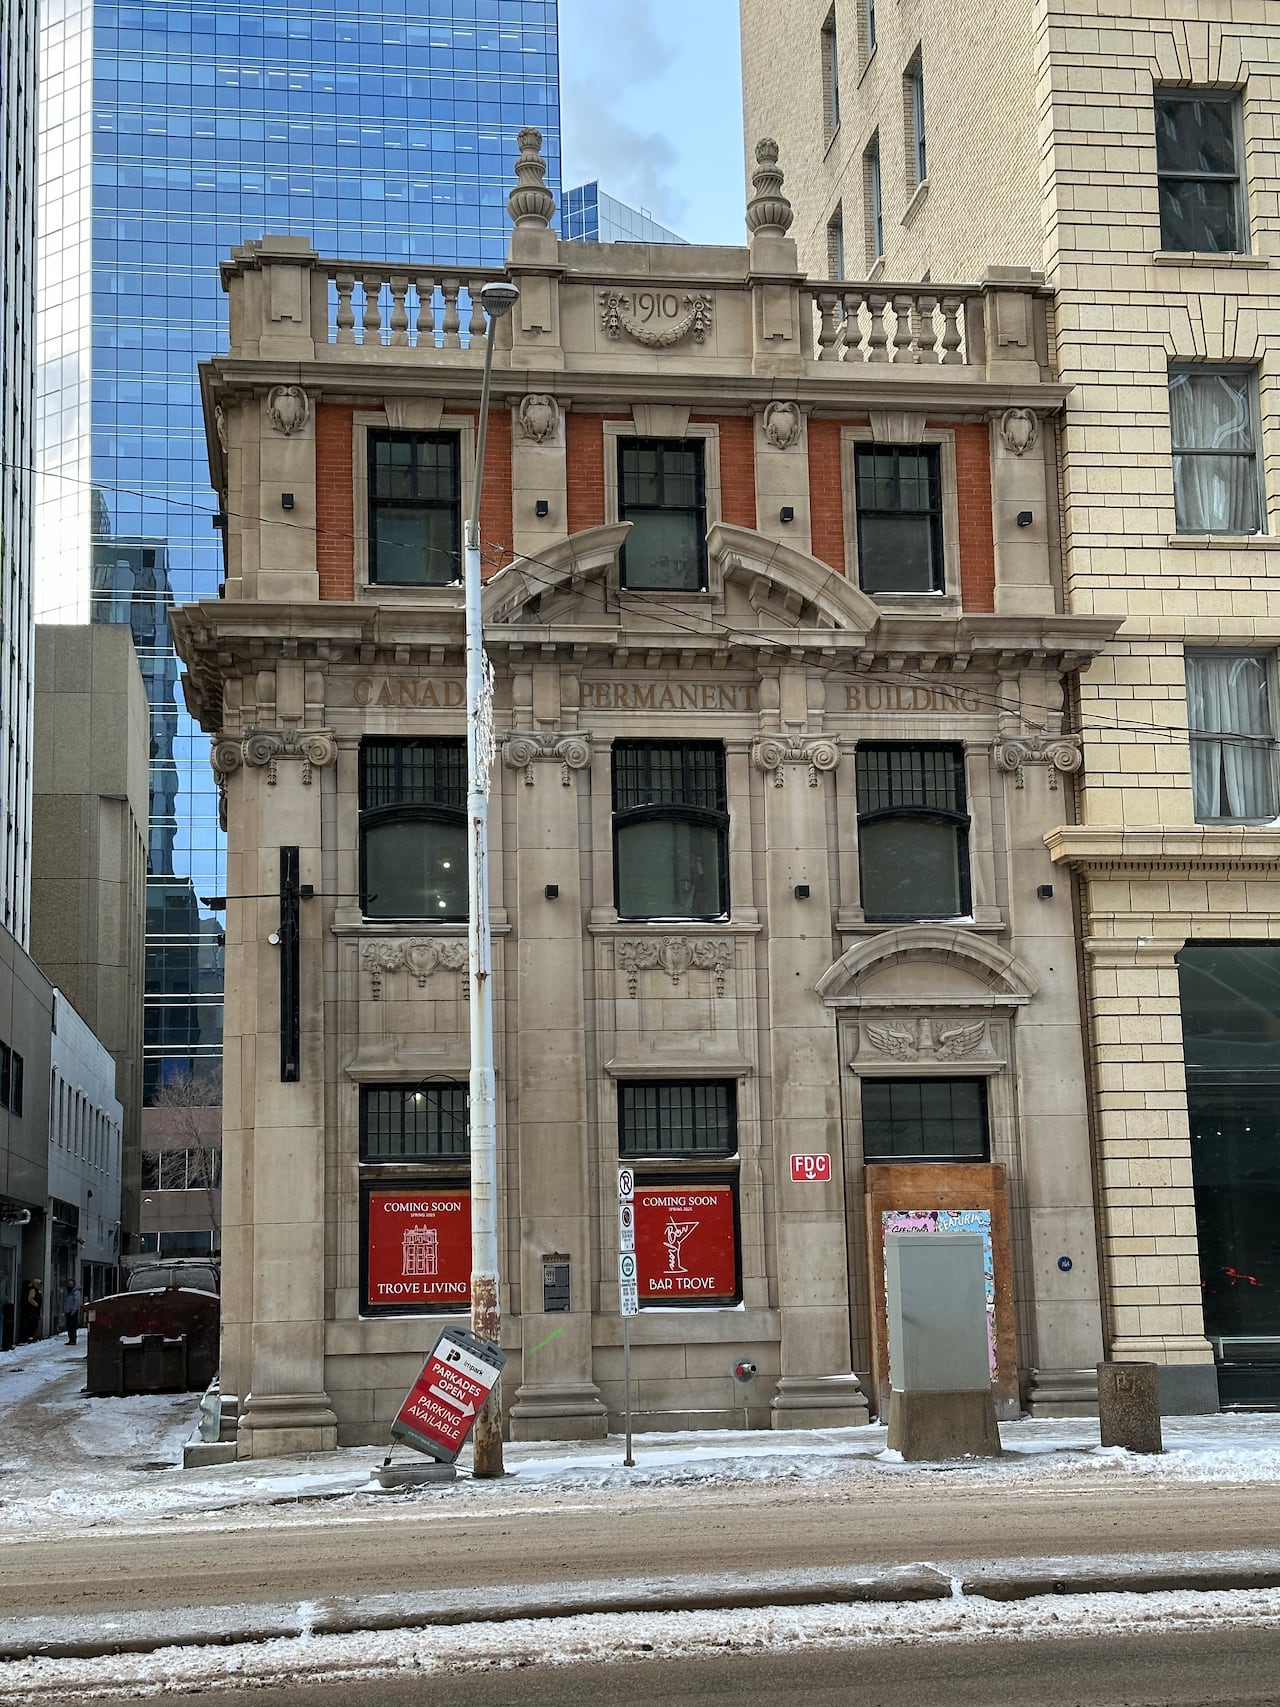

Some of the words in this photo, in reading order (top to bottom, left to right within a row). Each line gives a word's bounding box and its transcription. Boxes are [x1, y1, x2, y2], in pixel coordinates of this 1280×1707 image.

[632, 292, 679, 323] 1910
[352, 677, 467, 707] CANAD
[579, 682, 759, 711] PERMANENT
[844, 684, 982, 712] BUILDING
[795, 1156, 826, 1172] FDC
[383, 1202, 429, 1213] COMING
[431, 1201, 462, 1212] SOON
[642, 1196, 686, 1207] COMING
[688, 1196, 717, 1206] SOON
[377, 1282, 420, 1294] TROVE
[423, 1282, 467, 1294] LIVING
[649, 1278, 673, 1290] BAR
[675, 1277, 715, 1289] TROVE
[463, 1360, 485, 1377] impark
[431, 1362, 482, 1397] PARKADES
[438, 1379, 466, 1400] OPEN
[417, 1395, 462, 1426] PARKING
[407, 1405, 461, 1440] AVAILABLE
